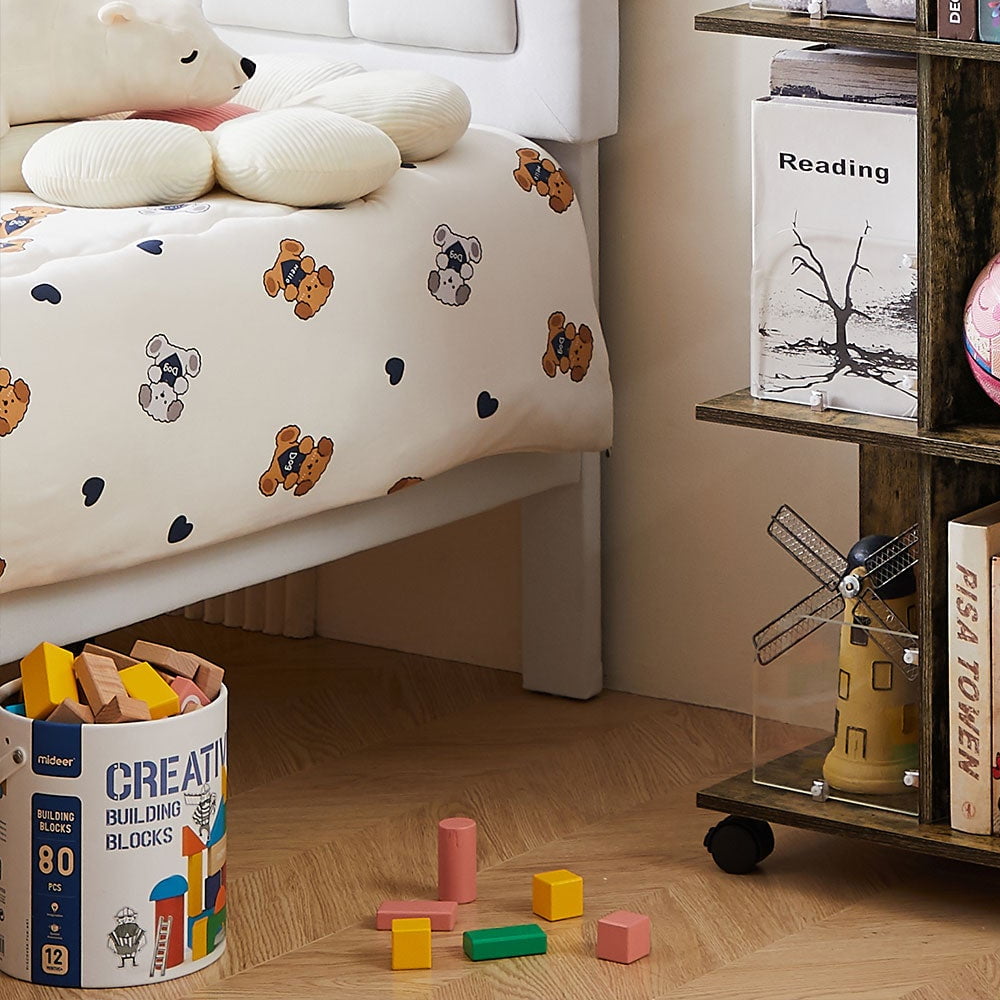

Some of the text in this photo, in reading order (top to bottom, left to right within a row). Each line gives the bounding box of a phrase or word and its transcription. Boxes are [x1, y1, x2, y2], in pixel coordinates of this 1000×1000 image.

[779, 152, 889, 185] Reading
[449, 249, 463, 263] Dog
[162, 362, 179, 377] Dog
[284, 452, 298, 472] Dog
[956, 562, 981, 781] PISA TOWEN
[37, 755, 74, 767] mideer
[37, 809, 75, 822] BUILDING
[105, 800, 181, 826] BUILDING
[40, 821, 72, 834] BLOCKS
[105, 827, 173, 851] BLOCKS
[38, 844, 75, 876] 80
[47, 882, 62, 892] PCS
[45, 947, 63, 966] 12
